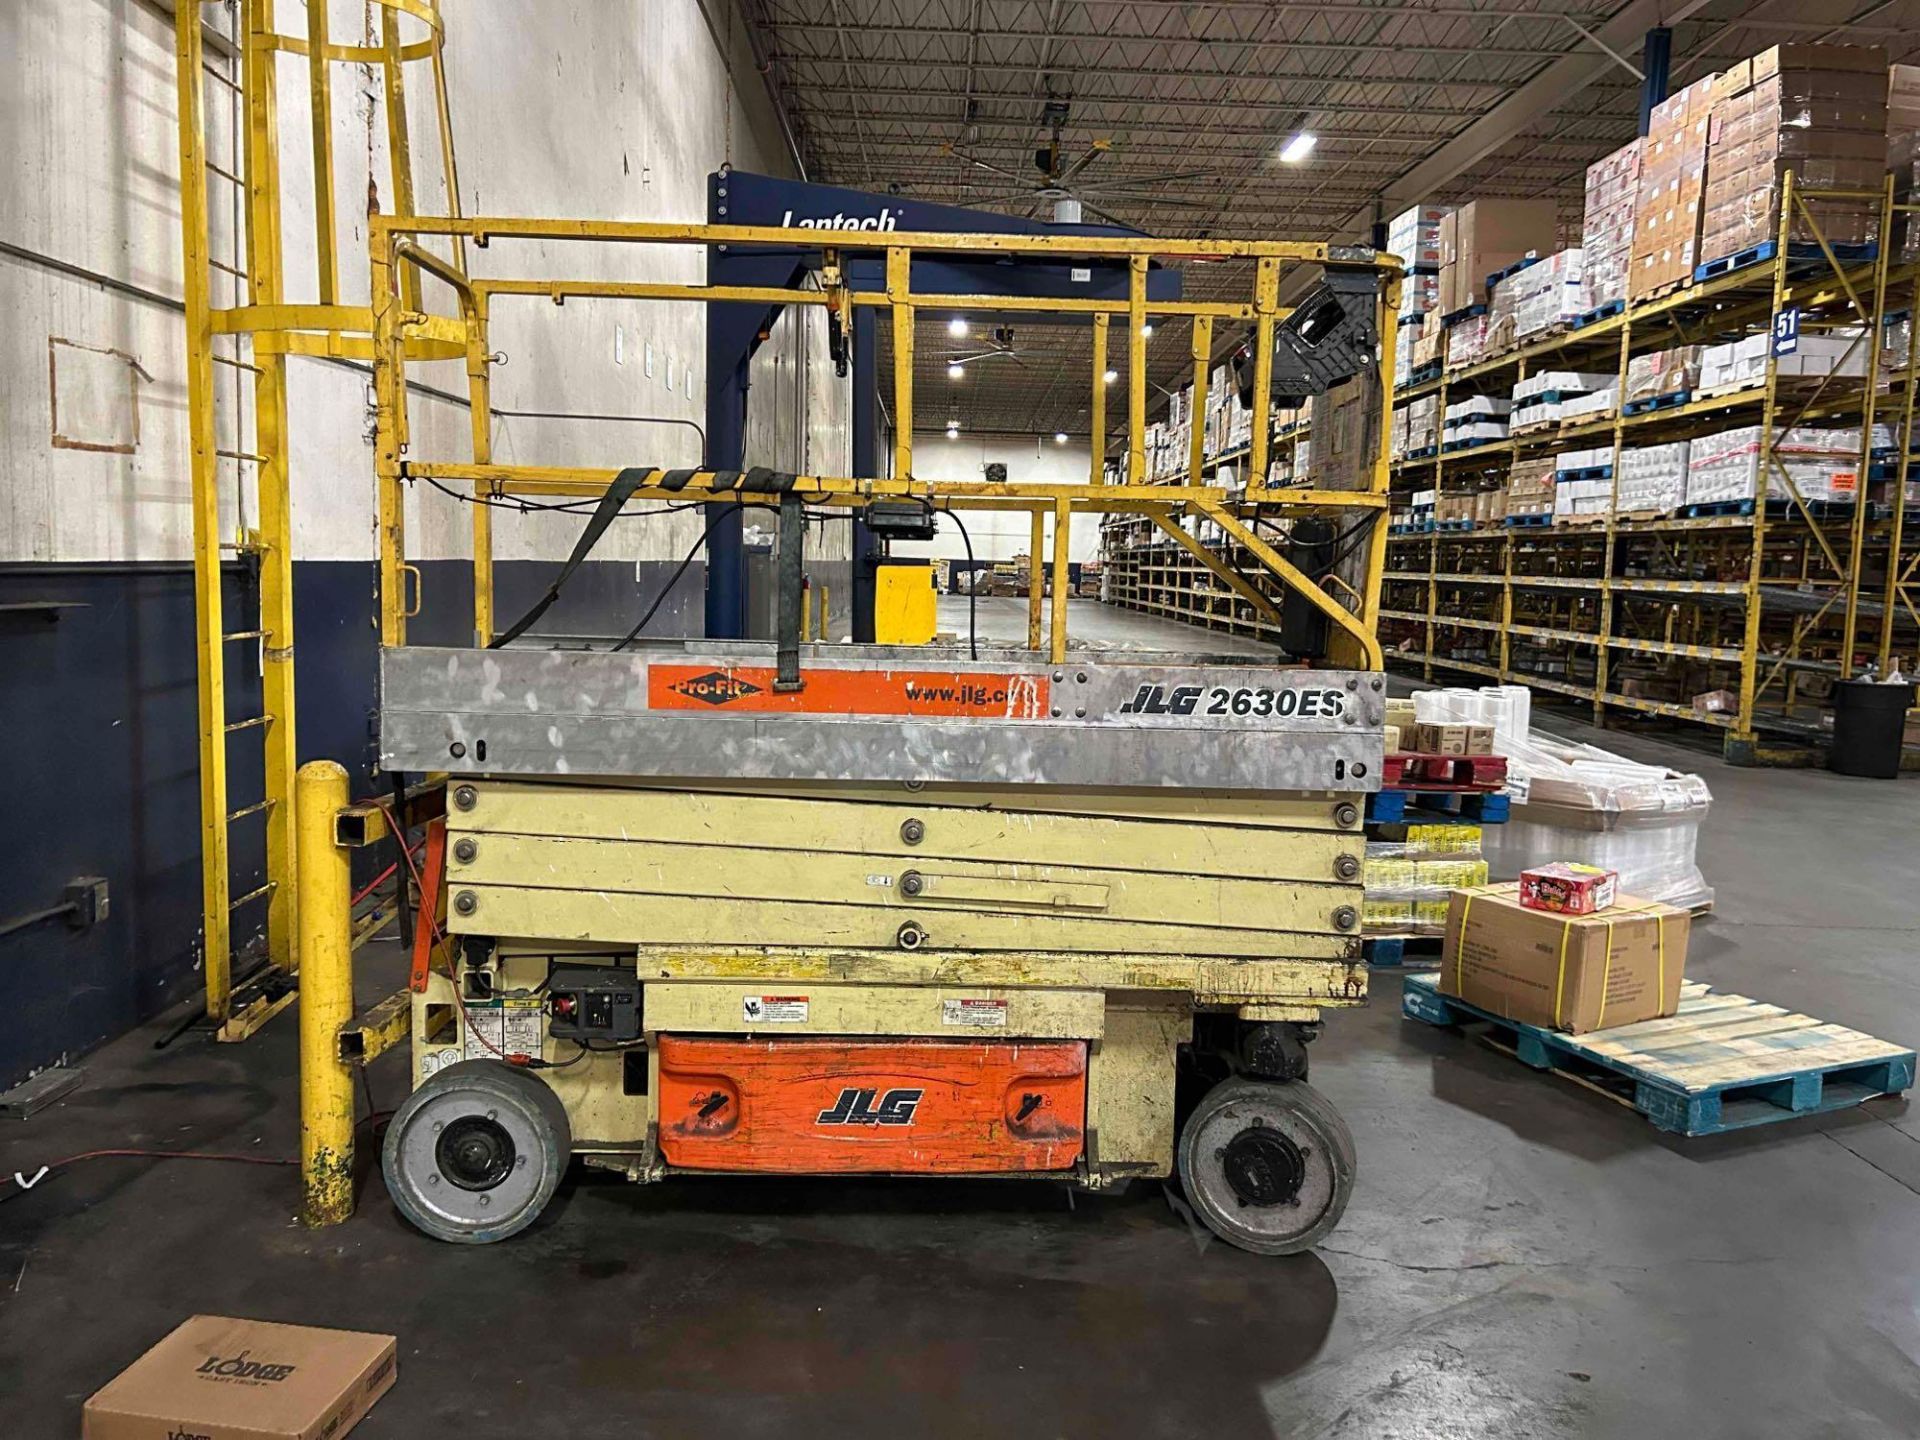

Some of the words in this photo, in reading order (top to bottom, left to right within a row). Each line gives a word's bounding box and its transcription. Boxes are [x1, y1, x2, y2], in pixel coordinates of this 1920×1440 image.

[1777, 309, 1796, 338] 51
[675, 680, 744, 695] Pro-Fit
[1119, 685, 1204, 715] JLG
[1206, 687, 1345, 717] 2630ES
[815, 1087, 925, 1126] JLG
[195, 1350, 296, 1381] LODGE
